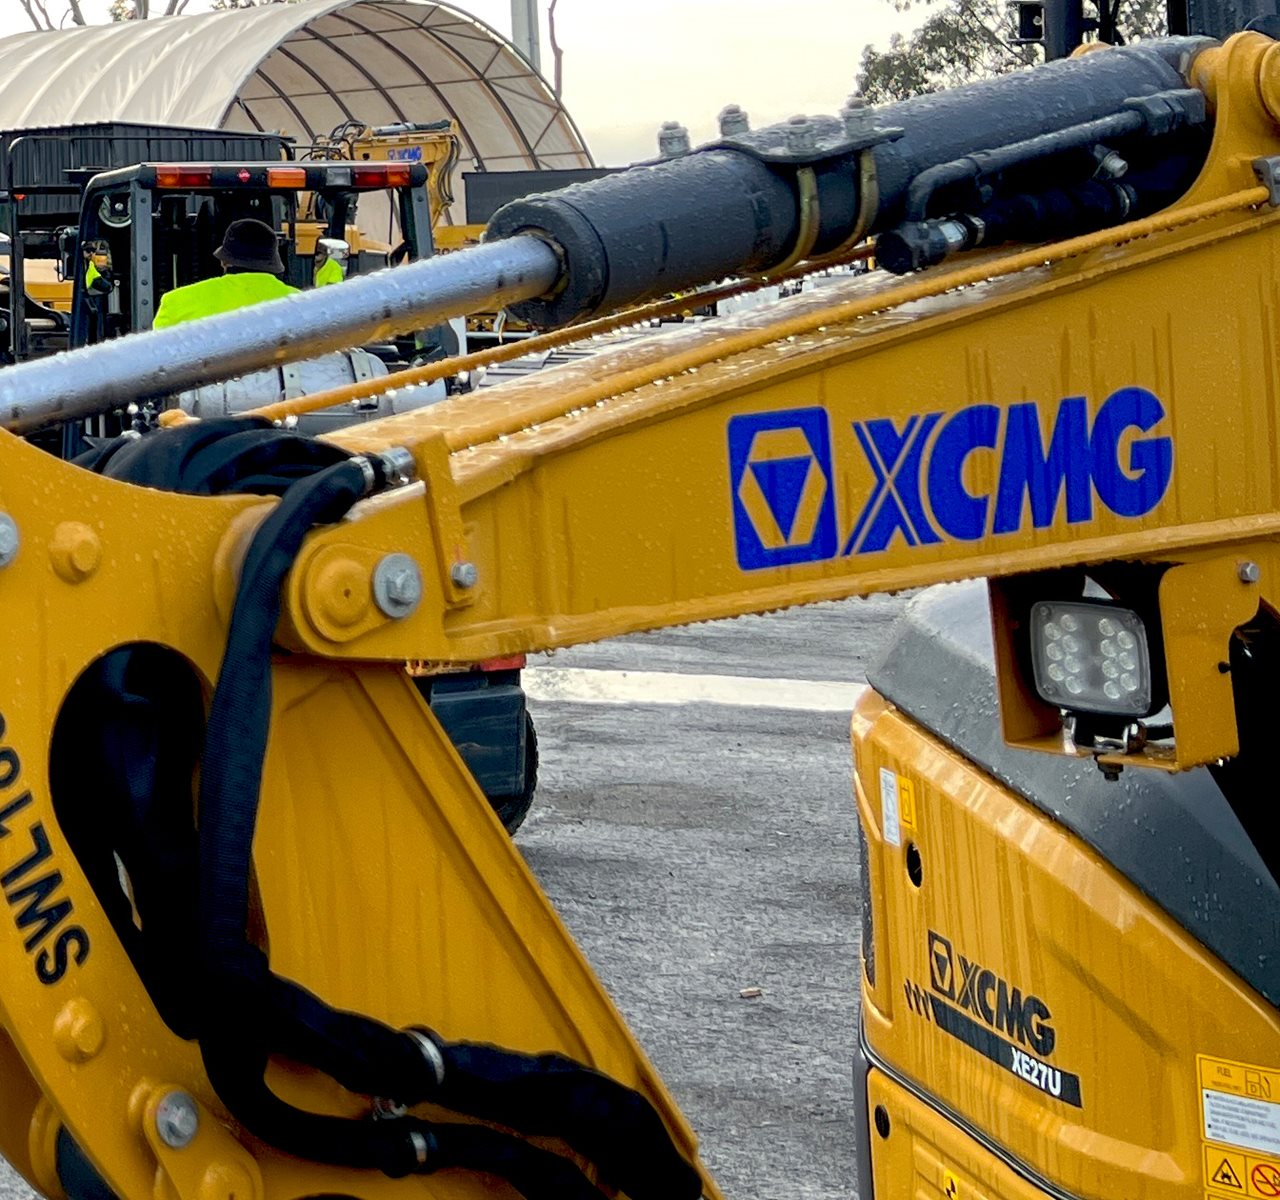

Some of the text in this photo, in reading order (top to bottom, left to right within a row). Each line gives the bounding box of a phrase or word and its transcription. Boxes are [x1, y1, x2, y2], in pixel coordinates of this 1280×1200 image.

[841, 386, 1174, 557] XCMG
[956, 953, 1056, 1057] XCMG
[1011, 1046, 1062, 1097] XE27U
